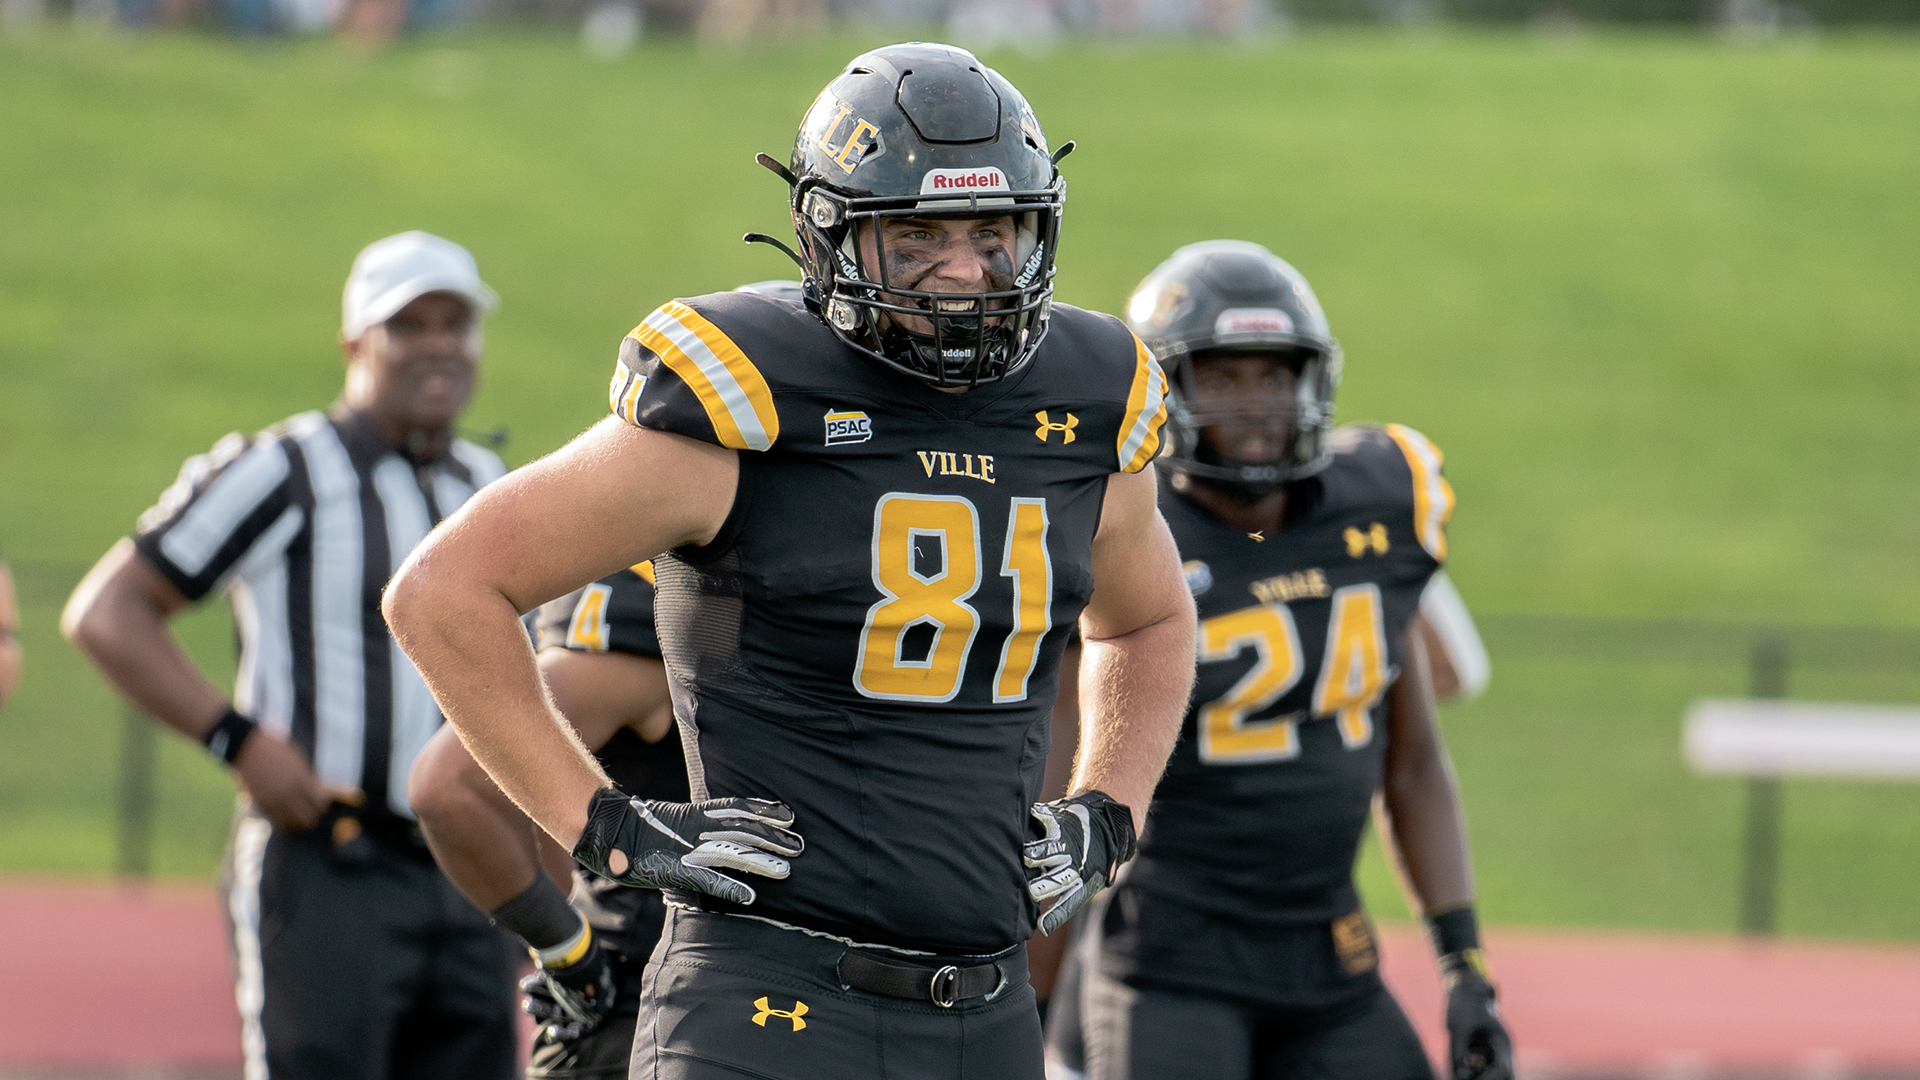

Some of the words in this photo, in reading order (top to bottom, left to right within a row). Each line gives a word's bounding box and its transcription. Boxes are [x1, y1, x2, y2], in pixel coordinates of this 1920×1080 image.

[934, 172, 1000, 189] Riddell
[1014, 239, 1044, 288] Ridde
[828, 419, 869, 437] PSAC
[916, 450, 996, 485] VILLE
[853, 491, 1053, 704] 81
[1198, 582, 1402, 766] 24
